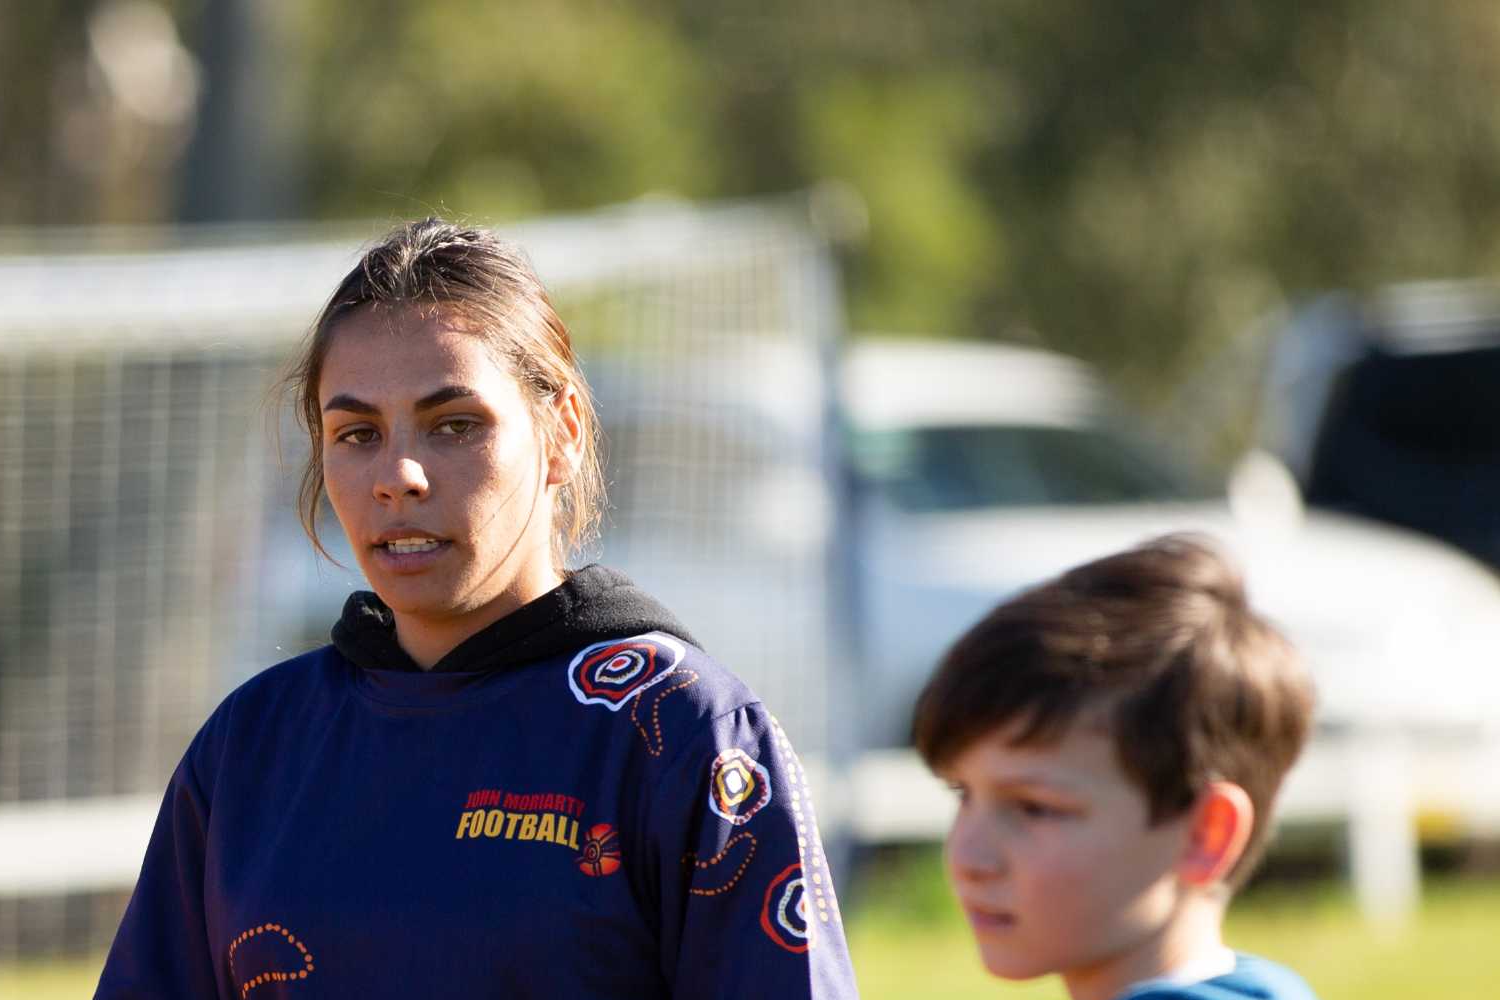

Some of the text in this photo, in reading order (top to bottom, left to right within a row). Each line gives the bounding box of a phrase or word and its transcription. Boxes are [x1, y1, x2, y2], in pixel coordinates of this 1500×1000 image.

[464, 789, 585, 817] JOHN MORIARTY
[455, 808, 580, 850] FOOTBALL
